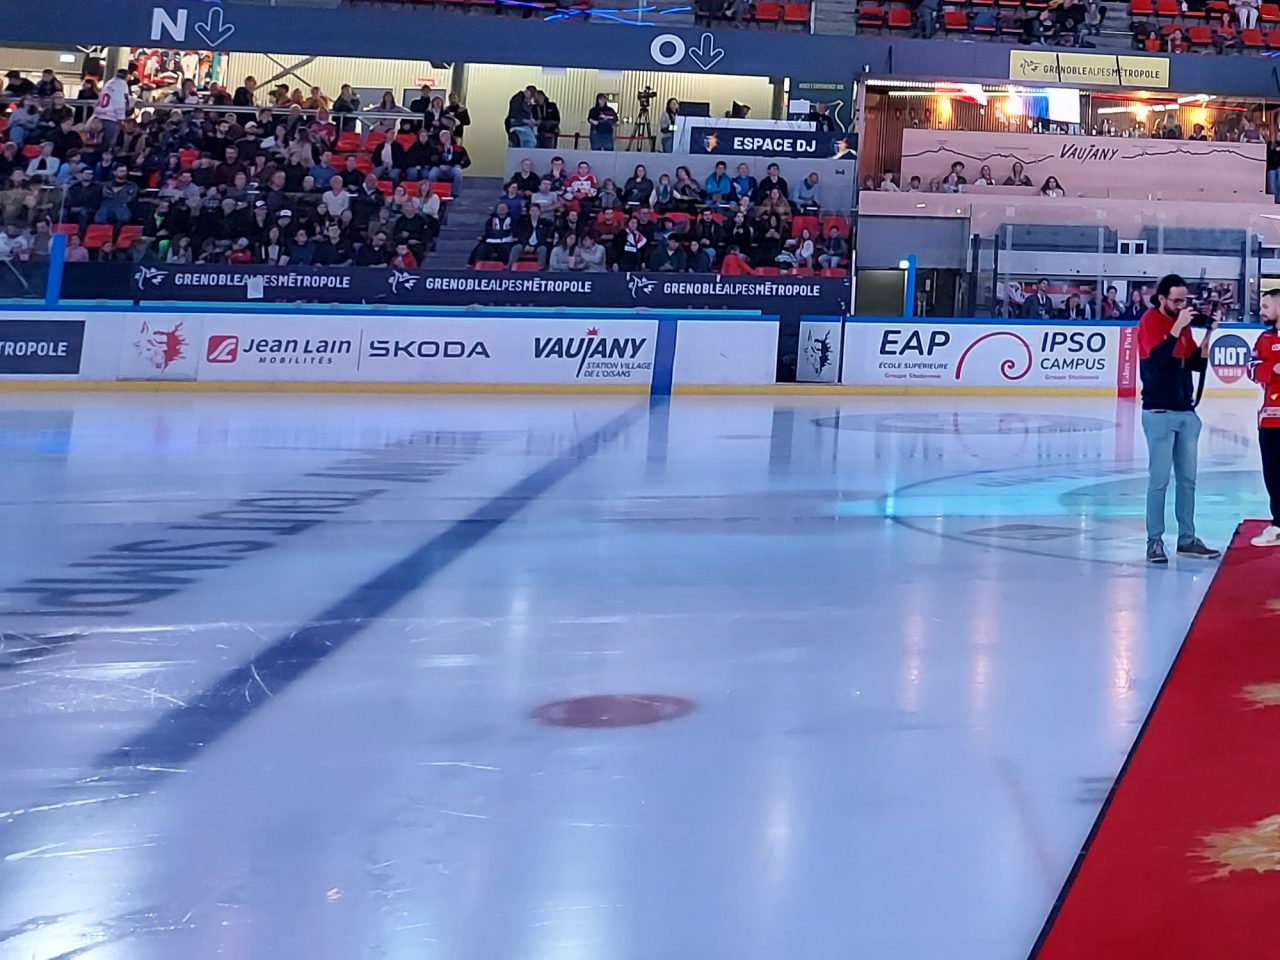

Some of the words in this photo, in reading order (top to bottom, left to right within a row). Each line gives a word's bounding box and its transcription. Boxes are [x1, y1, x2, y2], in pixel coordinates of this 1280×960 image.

[151, 7, 188, 41] N
[650, 33, 686, 66] O
[733, 136, 793, 152] ESPACE
[796, 137, 817, 152] DJ
[1059, 144, 1119, 164] VAUJANY
[243, 338, 299, 353] Jean
[303, 338, 351, 354] Lain
[879, 329, 951, 356] EAP
[1041, 331, 1106, 353] IPSO
[259, 356, 333, 365] MOBILITÉS
[534, 337, 647, 378] VAUJANY
[586, 361, 619, 370] STATION
[620, 362, 652, 370] VILLAGE
[1040, 357, 1106, 370] CAMPUS
[1214, 346, 1247, 366] HOT
